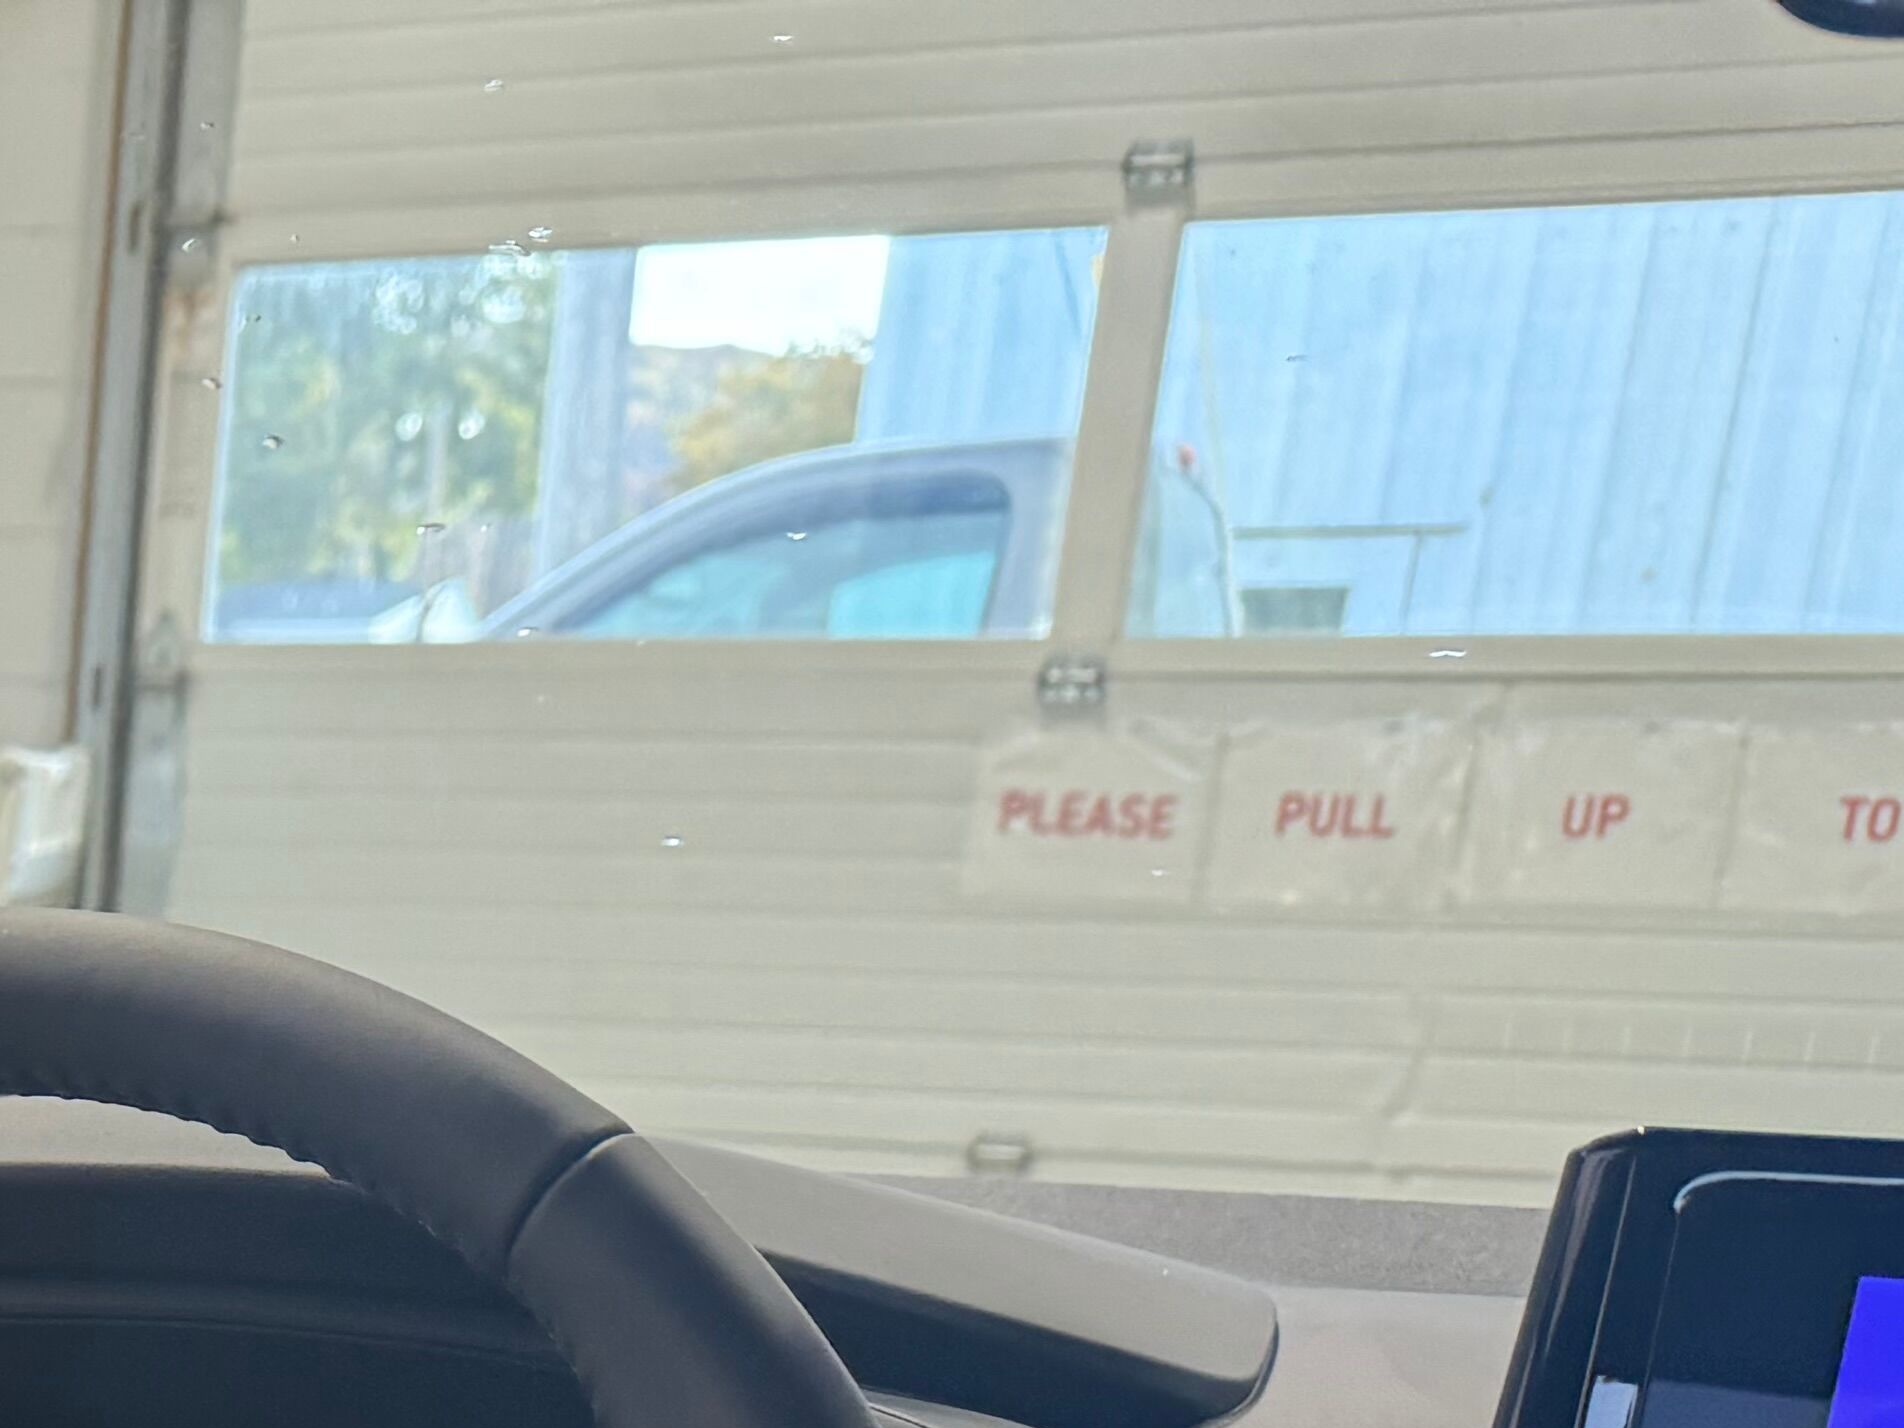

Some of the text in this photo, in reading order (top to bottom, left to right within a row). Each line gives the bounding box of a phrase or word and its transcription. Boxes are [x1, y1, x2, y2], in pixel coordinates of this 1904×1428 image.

[997, 788, 1901, 842] PLEASE PULL UP TO
